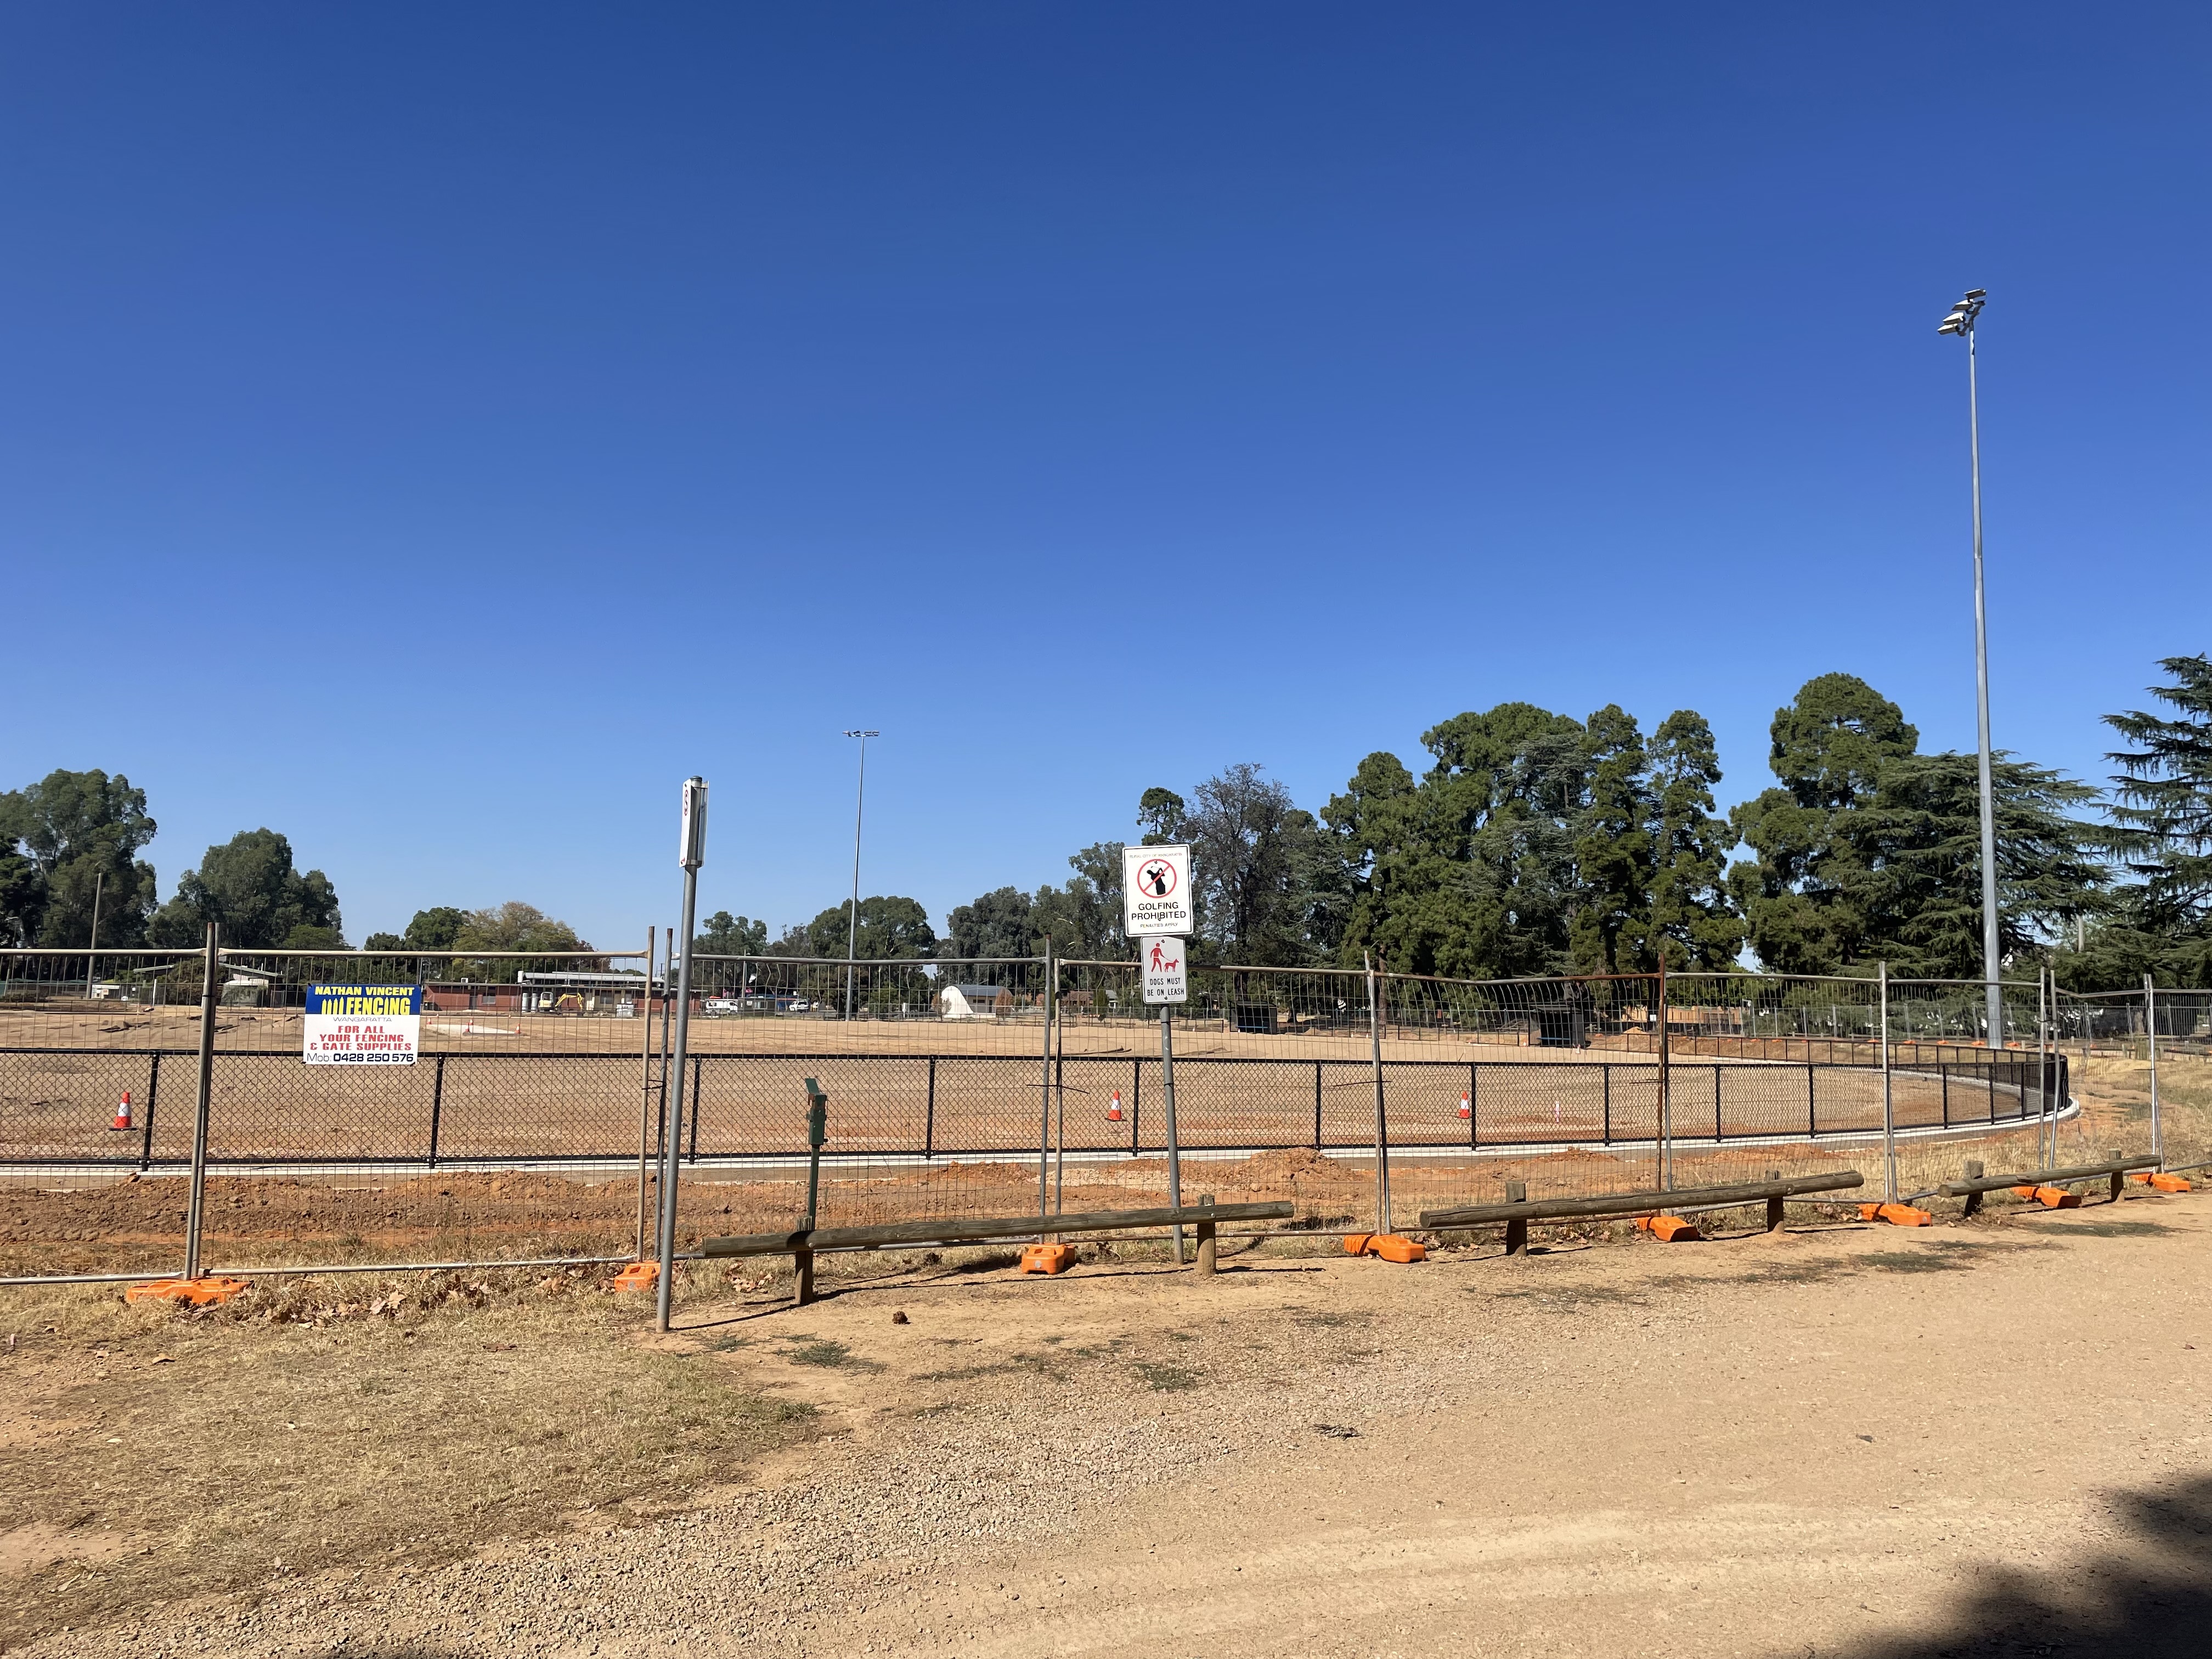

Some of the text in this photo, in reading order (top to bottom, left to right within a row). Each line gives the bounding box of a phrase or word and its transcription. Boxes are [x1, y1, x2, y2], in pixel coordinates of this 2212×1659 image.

[1138, 902, 1178, 910] GOLFING
[1131, 911, 1186, 920] PROHIBITED
[315, 986, 414, 996] NATHAN VINCENT
[307, 1053, 331, 1062] Mob:
[334, 1053, 364, 1062] 0428
